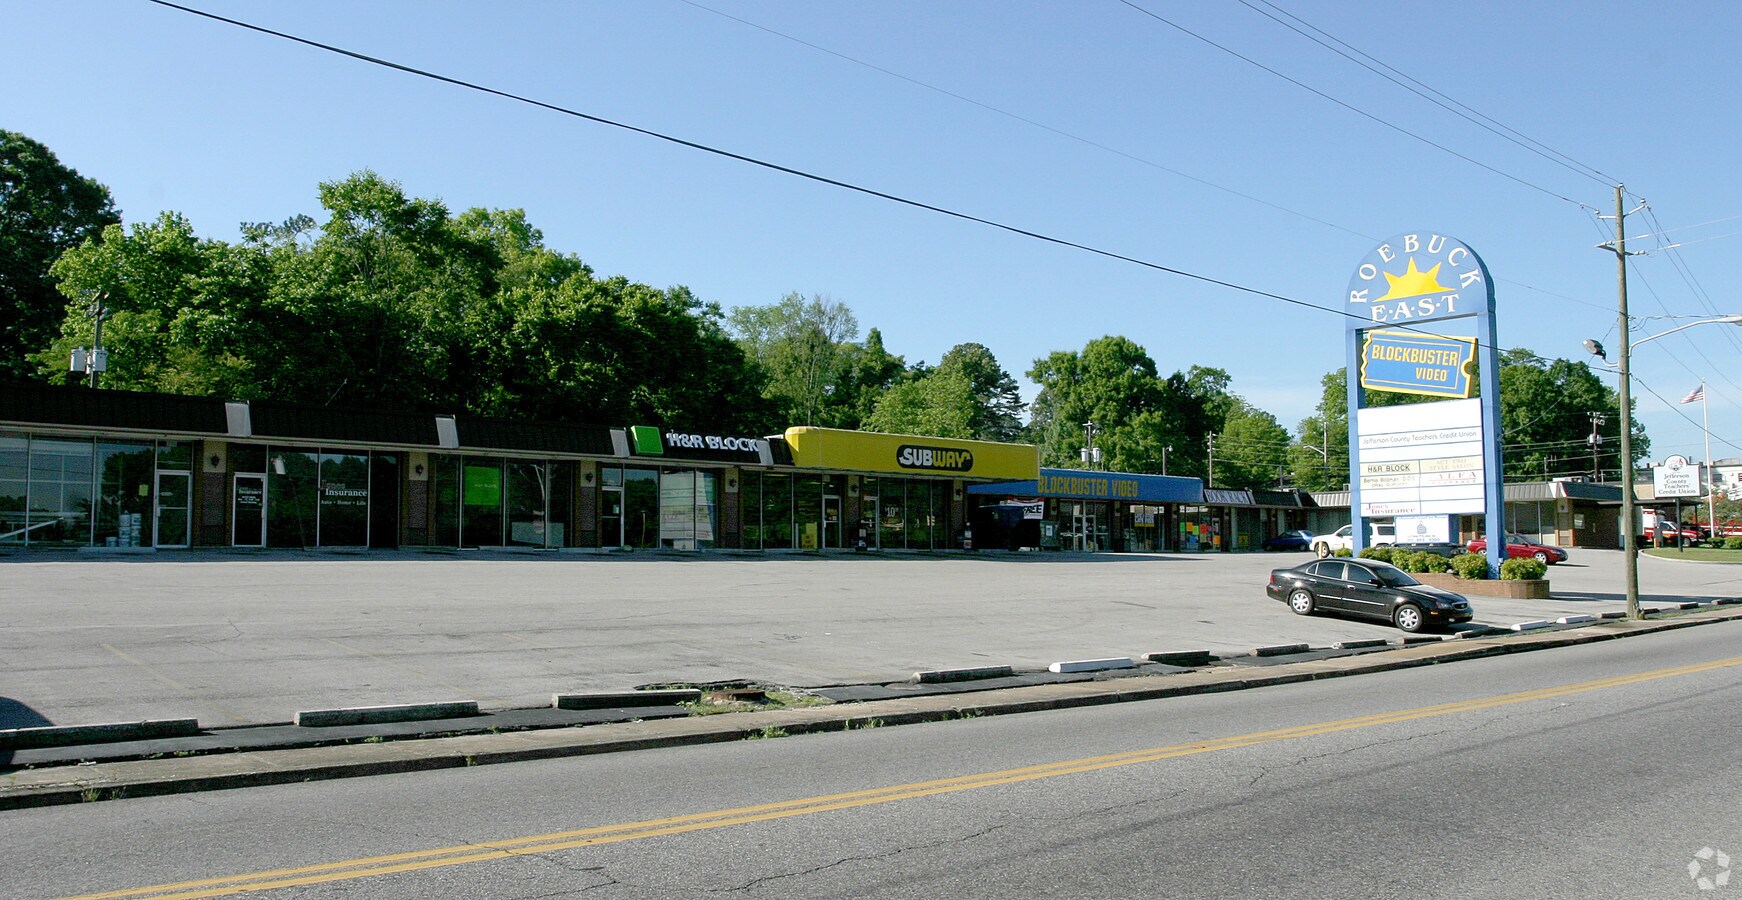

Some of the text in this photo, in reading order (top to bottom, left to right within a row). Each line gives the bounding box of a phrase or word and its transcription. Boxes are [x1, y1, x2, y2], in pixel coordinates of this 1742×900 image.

[1350, 234, 1481, 304] ROEBUCK
[1371, 344, 1458, 366] BLOCKBUSTER
[1415, 367, 1448, 382] VIDEO
[666, 432, 760, 452] H&R BLOCK
[1363, 430, 1477, 445] Jefferson County Teachers Credit Union
[899, 447, 971, 468] SUBWAY
[1367, 463, 1411, 473] H&R BLOCK
[325, 488, 368, 497] Insurance
[1038, 475, 1138, 498] BLOCKBUSTER VIDEO
[1371, 507, 1416, 515] Insurance
